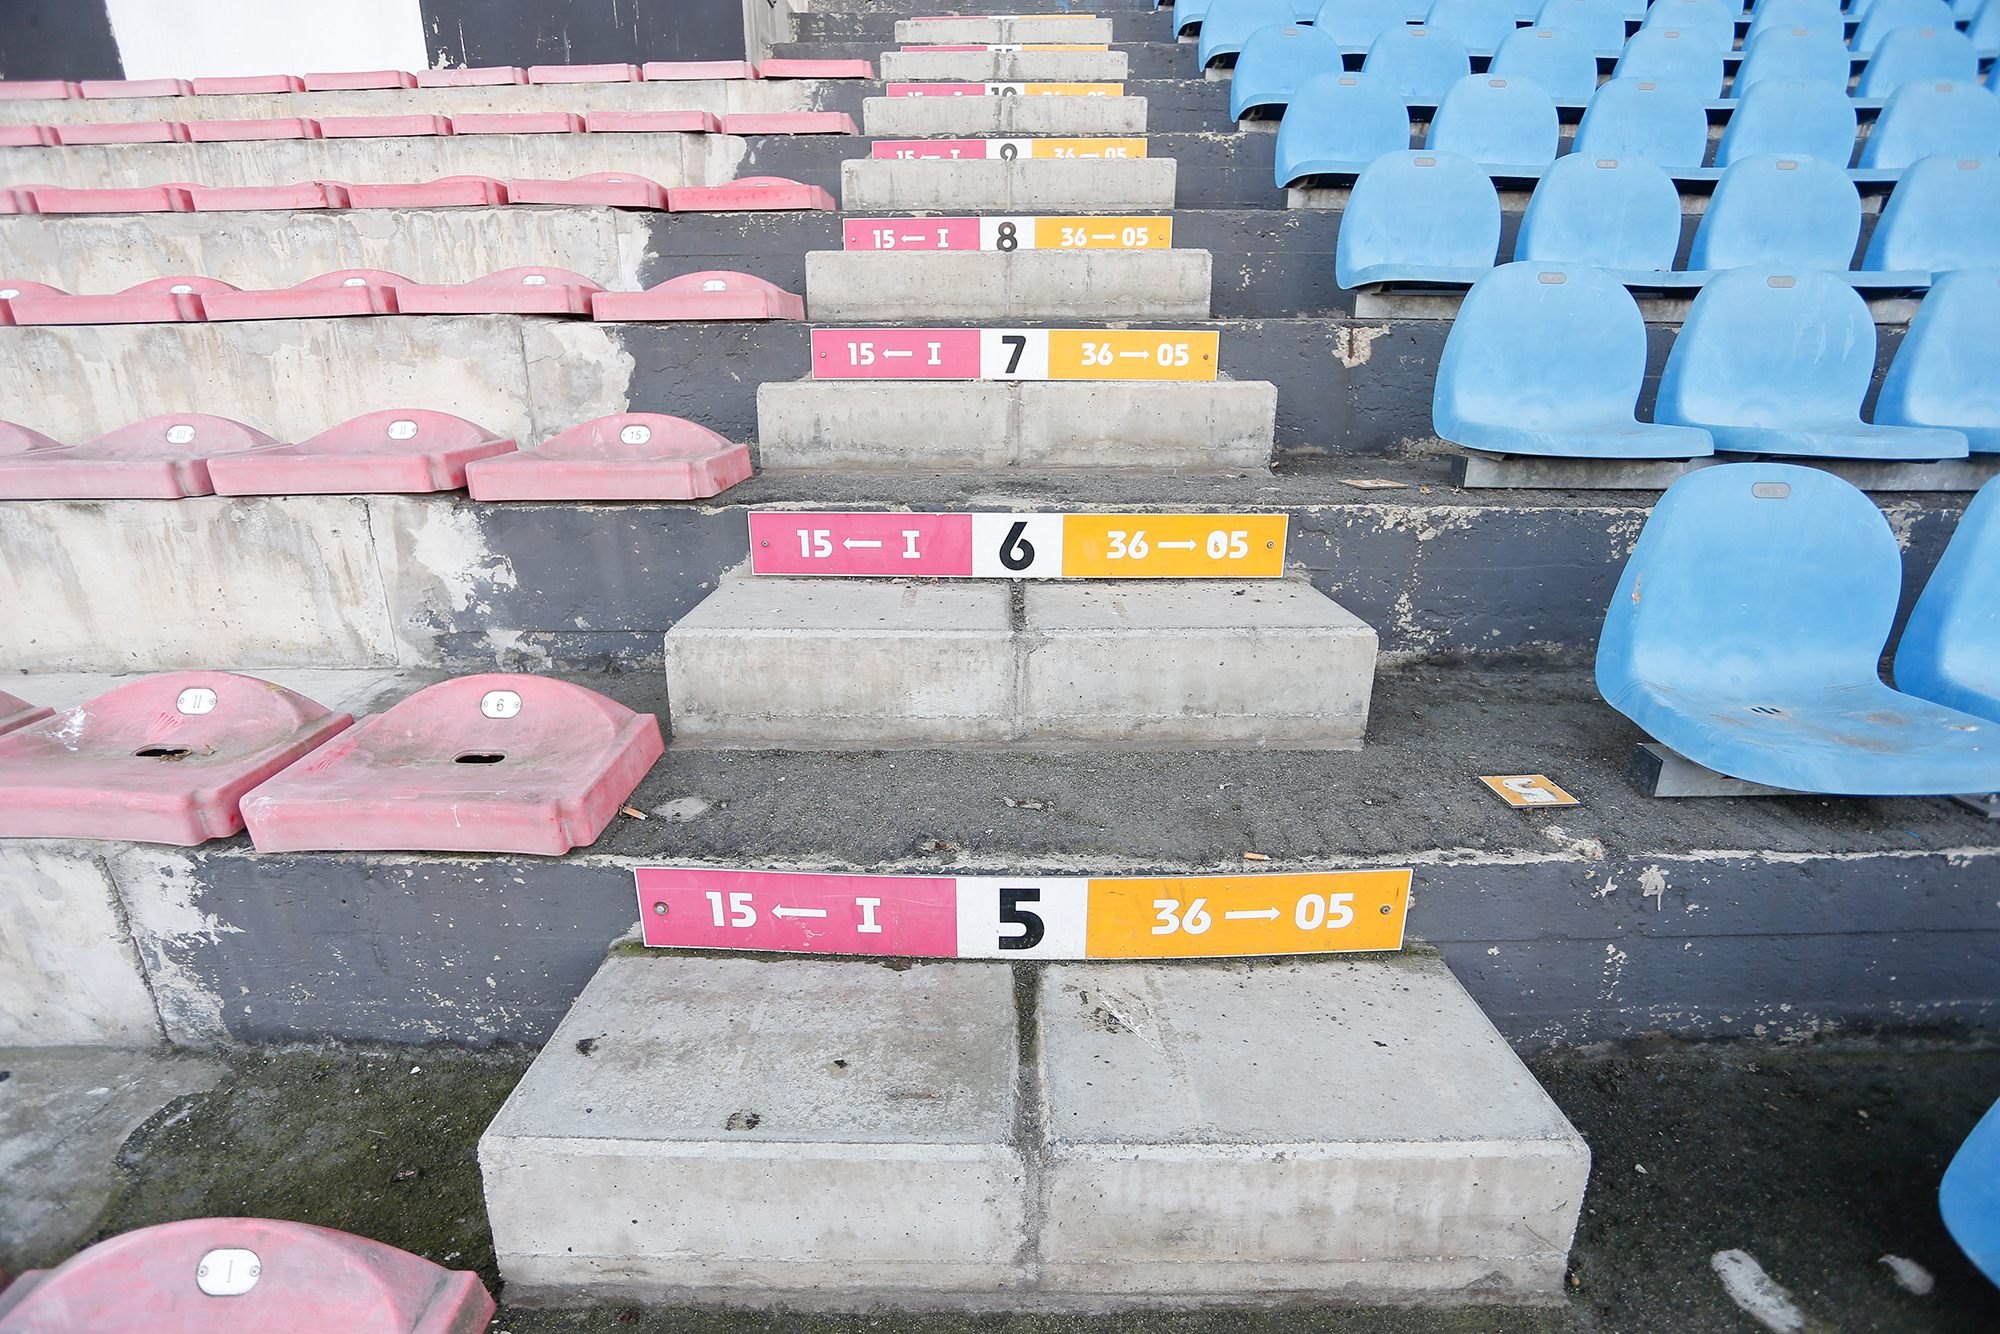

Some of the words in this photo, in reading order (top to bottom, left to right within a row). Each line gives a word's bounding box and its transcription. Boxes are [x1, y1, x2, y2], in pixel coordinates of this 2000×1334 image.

[1000, 143, 1018, 160] 9
[872, 229, 896, 248] 15
[937, 228, 950, 247] I
[997, 221, 1018, 252] 8
[1061, 227, 1088, 247] 36
[1122, 227, 1149, 246] 05
[847, 342, 875, 366] 15
[927, 342, 942, 366] I
[1002, 336, 1027, 373] 7
[1081, 342, 1114, 366] 36
[1157, 343, 1190, 366] 05
[631, 430, 642, 441] 15
[796, 529, 833, 558] 15
[902, 531, 920, 558] I
[999, 521, 1035, 570] 6
[1106, 530, 1150, 559] 36
[1206, 530, 1249, 559] 05
[496, 698, 505, 712] 6
[706, 891, 757, 928] 15
[856, 898, 882, 933] I
[999, 888, 1045, 950] 5
[1152, 899, 1212, 936] 36
[1295, 893, 1355, 931] 05
